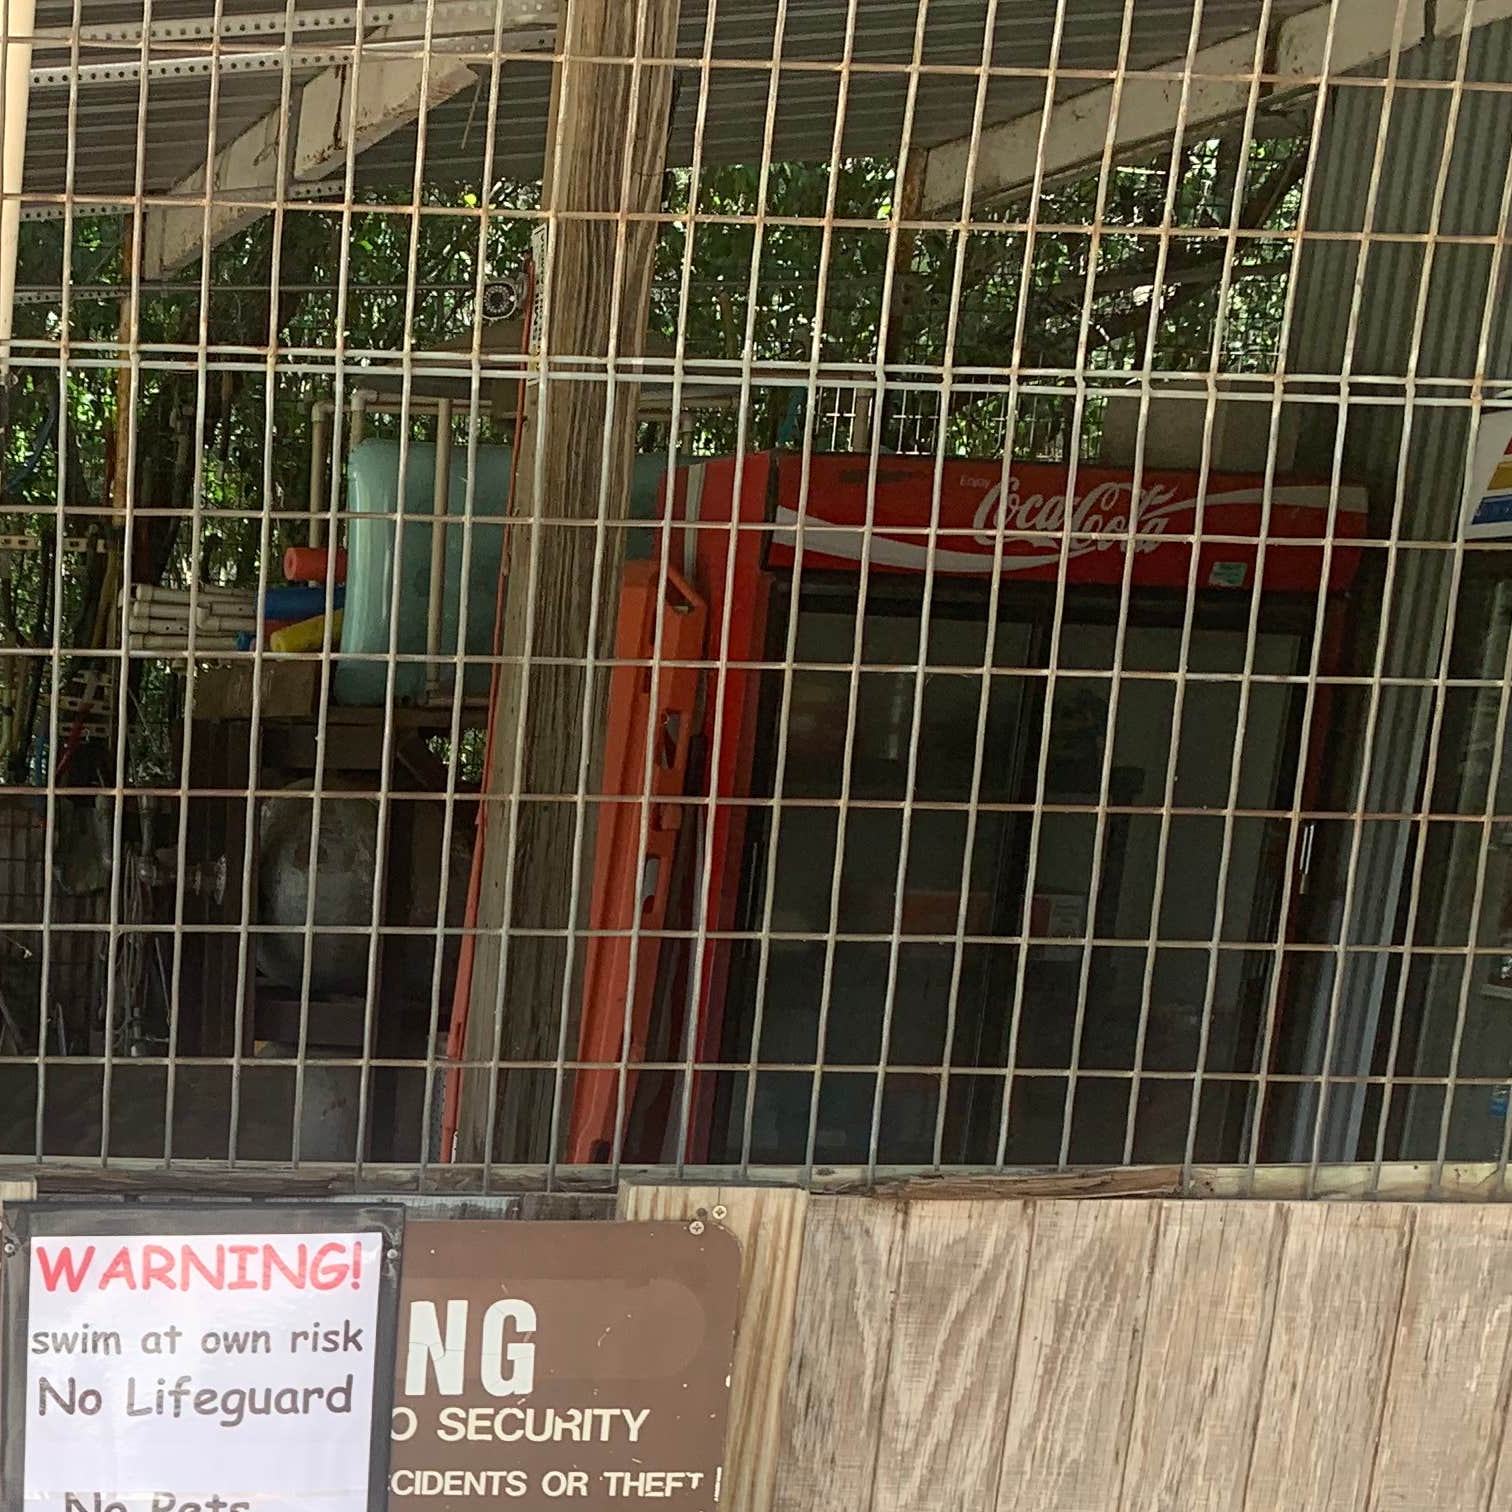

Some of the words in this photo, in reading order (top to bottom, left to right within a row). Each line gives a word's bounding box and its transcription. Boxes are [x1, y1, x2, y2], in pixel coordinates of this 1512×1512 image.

[37, 1242, 362, 1292] WARNING!
[32, 1323, 122, 1355] swim
[140, 1325, 183, 1355] at
[201, 1331, 271, 1354] own
[292, 1320, 362, 1352] risk
[40, 1378, 101, 1415] No
[127, 1374, 354, 1427] Lifeguard
[437, 1408, 649, 1441] SECURITY
[388, 1470, 528, 1496] CIDENTS
[542, 1471, 588, 1496] OR
